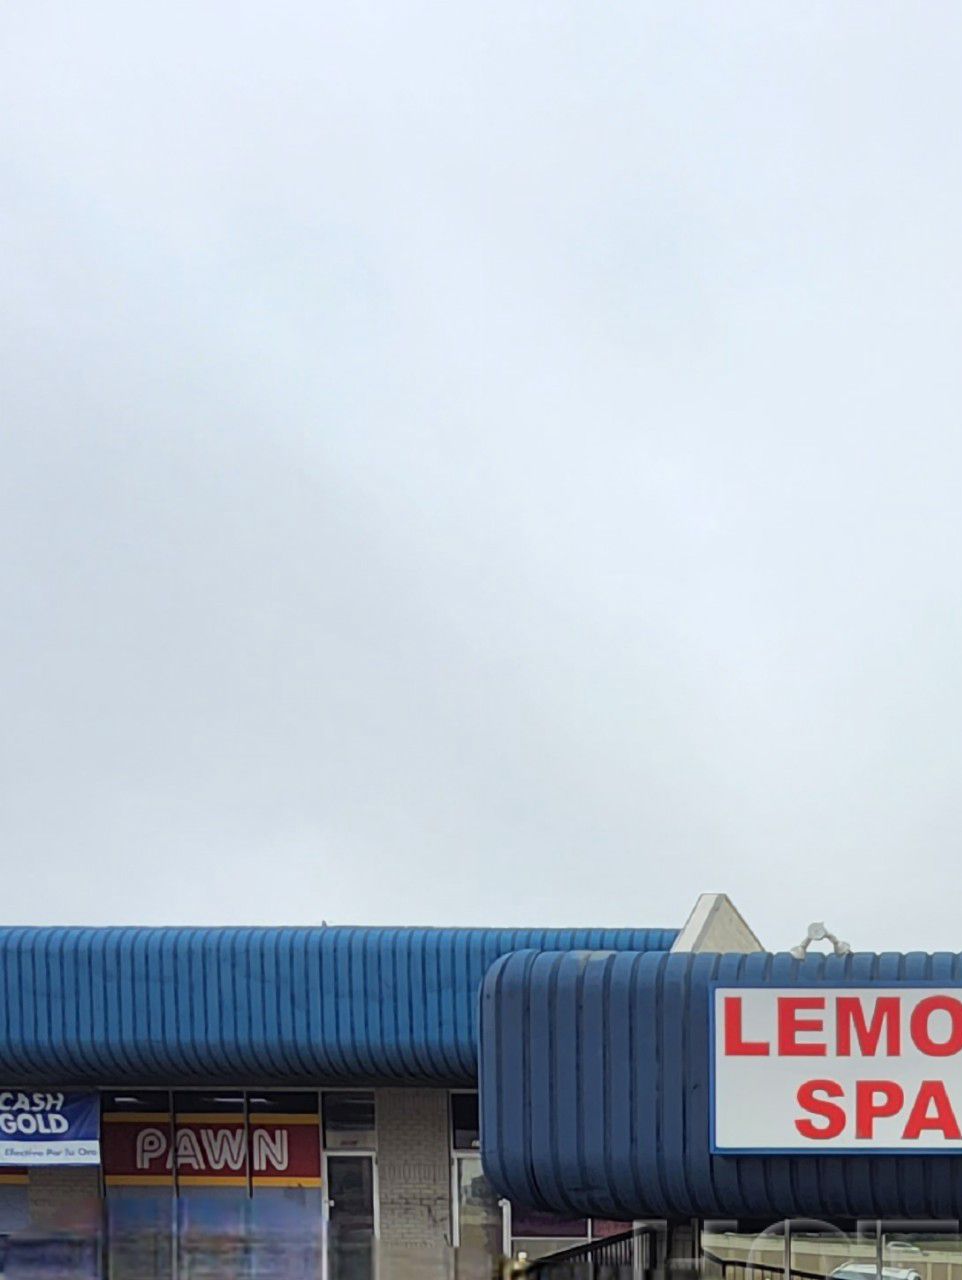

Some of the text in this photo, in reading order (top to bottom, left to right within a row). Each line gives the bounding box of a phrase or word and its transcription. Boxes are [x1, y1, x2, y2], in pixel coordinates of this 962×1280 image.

[0, 1092, 64, 1112] CASH
[794, 1079, 962, 1140] SPA
[0, 1113, 69, 1134] GOLD
[136, 1127, 289, 1171] PAWN
